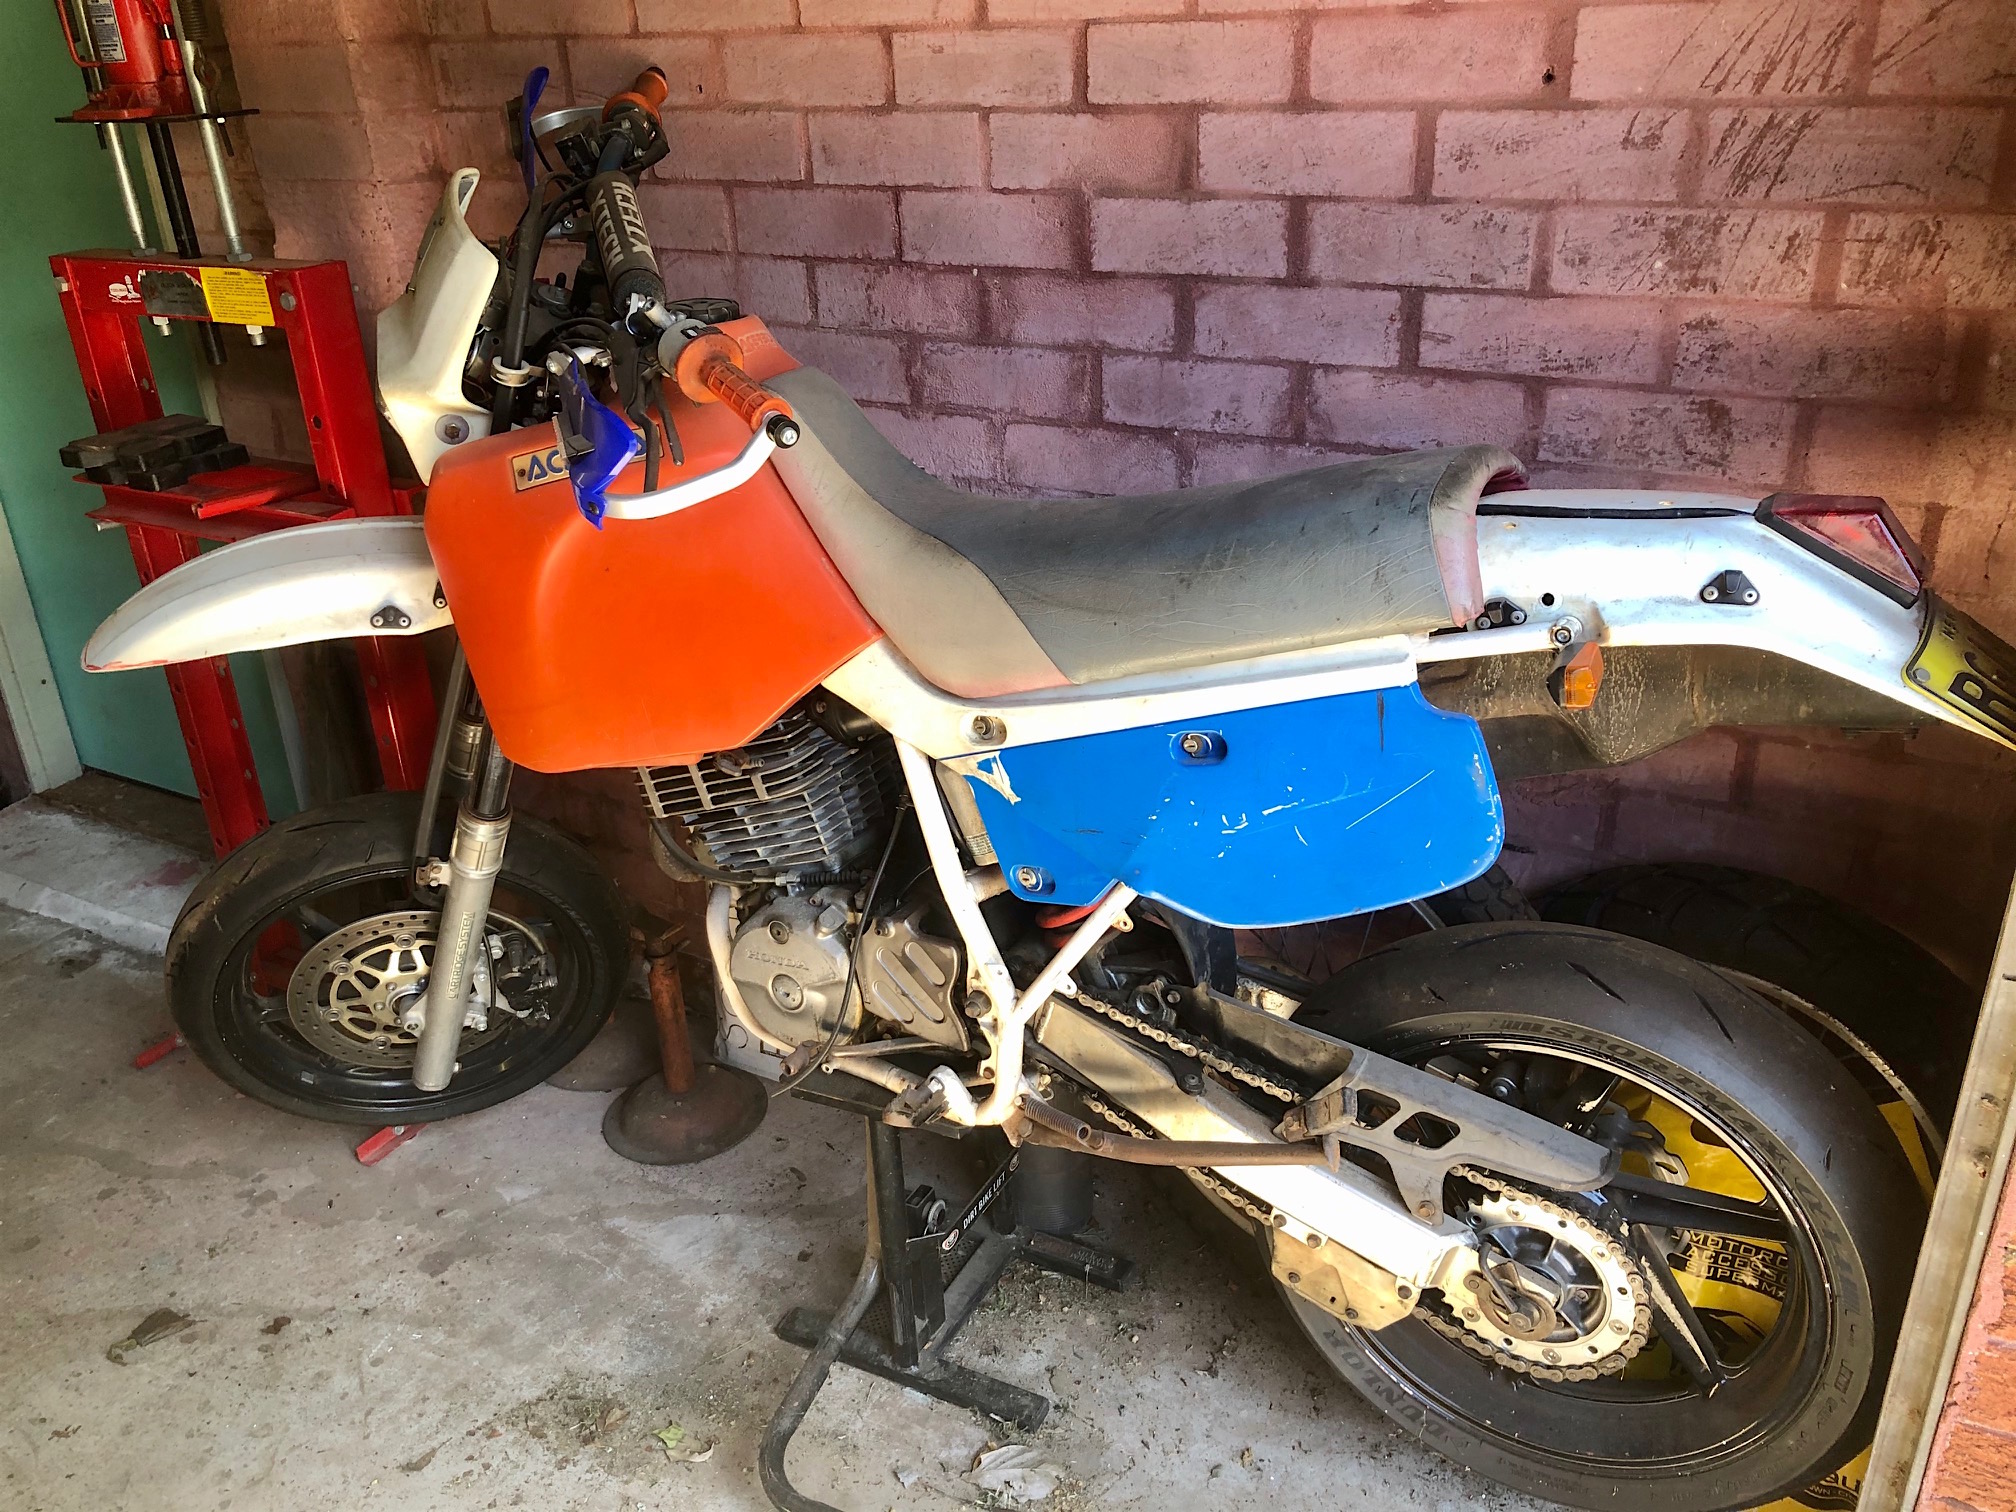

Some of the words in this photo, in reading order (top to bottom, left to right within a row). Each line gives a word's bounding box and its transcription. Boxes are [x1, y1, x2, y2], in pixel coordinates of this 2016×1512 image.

[745, 949, 809, 971] HONDA
[962, 1206, 979, 1230] DIRT
[978, 1187, 993, 1211] BIKE
[993, 1171, 1006, 1192] LIFT
[1323, 1328, 1444, 1439] DUNLOP
